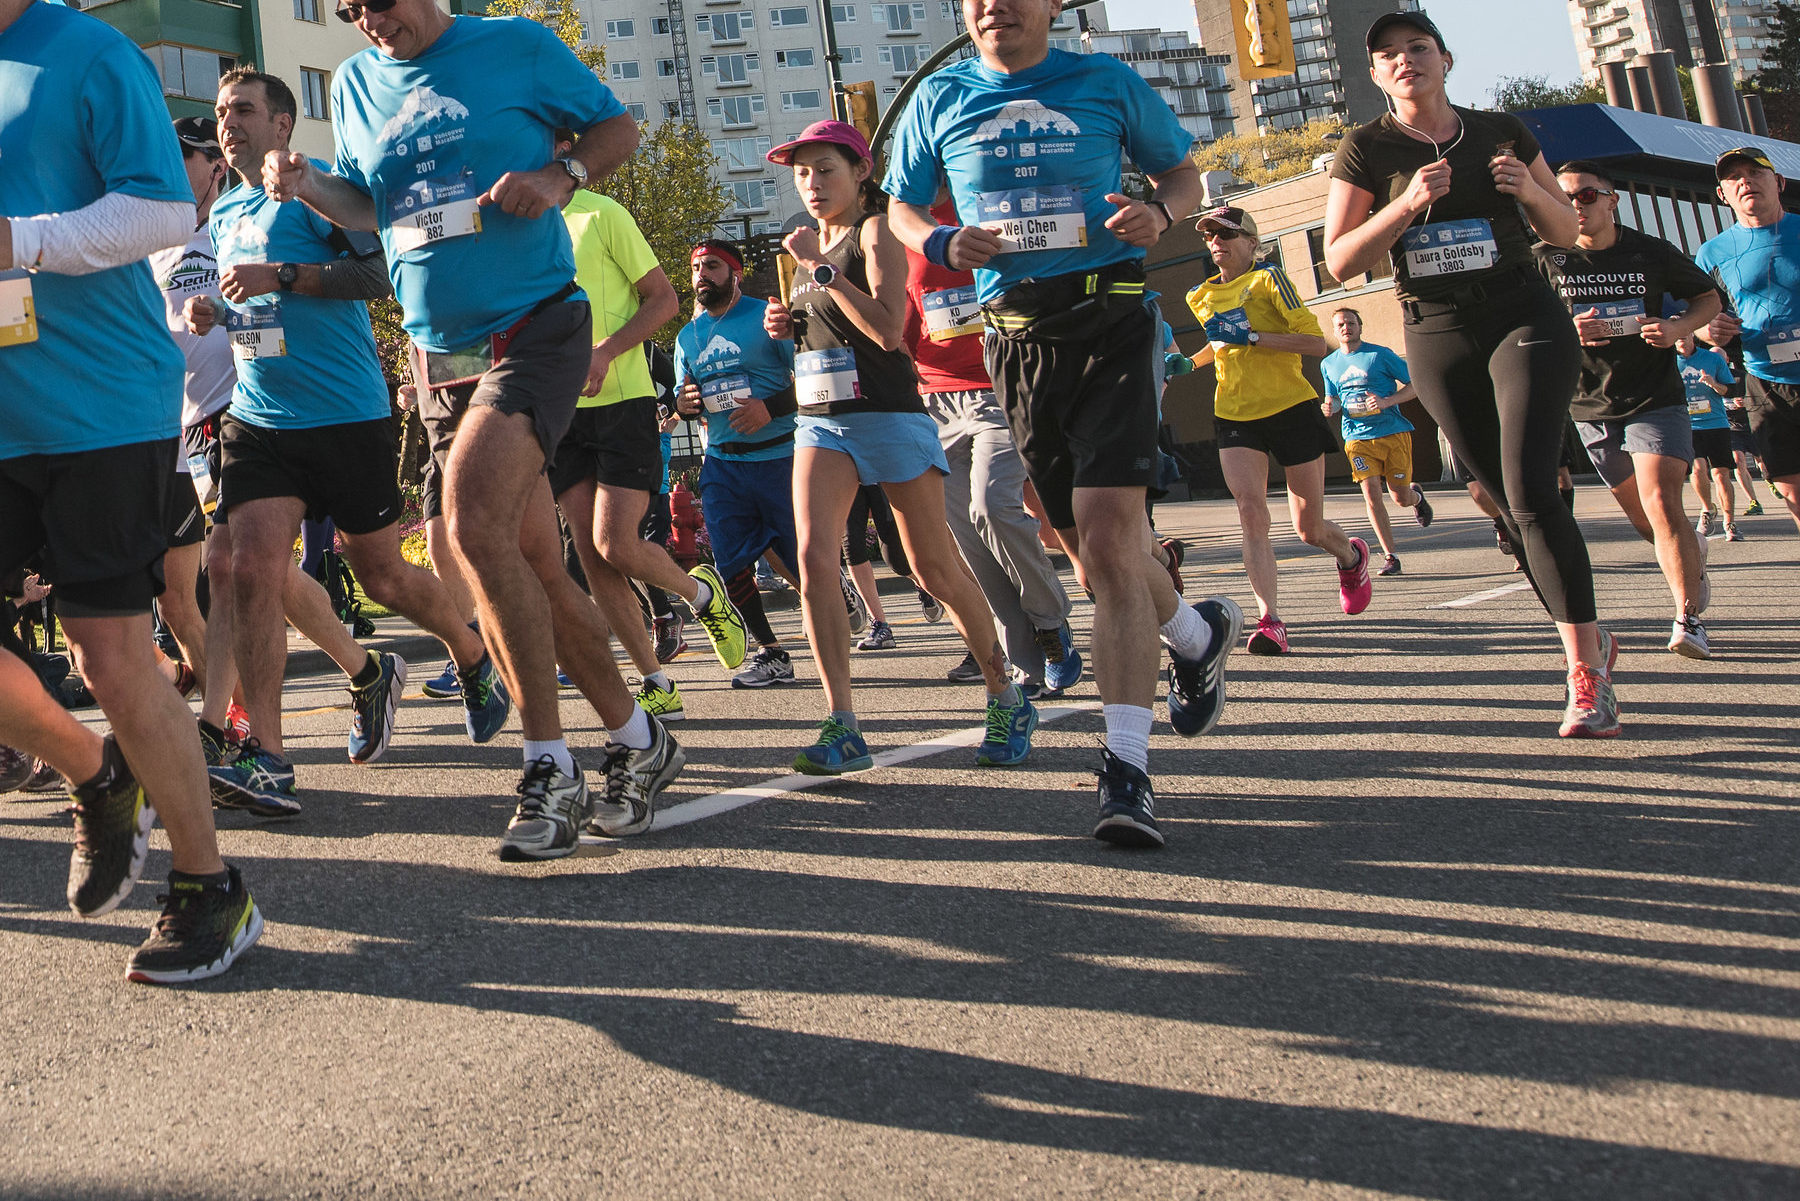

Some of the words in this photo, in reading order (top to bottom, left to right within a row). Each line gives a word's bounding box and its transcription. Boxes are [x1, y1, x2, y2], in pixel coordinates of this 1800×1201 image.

[433, 127, 465, 140] Vancouver
[435, 134, 464, 146] Marathon
[415, 159, 436, 174] 2017
[1014, 166, 1038, 178] 2017
[435, 183, 466, 193] Vancouver
[436, 189, 465, 199] Marathon
[415, 211, 443, 228] Victor
[1003, 221, 1024, 236] Wei
[1027, 219, 1057, 234] Chen
[1017, 235, 1047, 250] 11646
[1414, 251, 1440, 264] Laura
[1443, 244, 1484, 259] Goldsby
[1437, 260, 1465, 273] 13803
[168, 269, 220, 291] Seatt
[1557, 273, 1645, 285] VANCOUVER
[183, 283, 212, 293] RUNNING
[1560, 286, 1624, 297] RUNNING
[1627, 285, 1647, 295] CO
[949, 307, 961, 317] KD
[236, 331, 261, 345] NELSON
